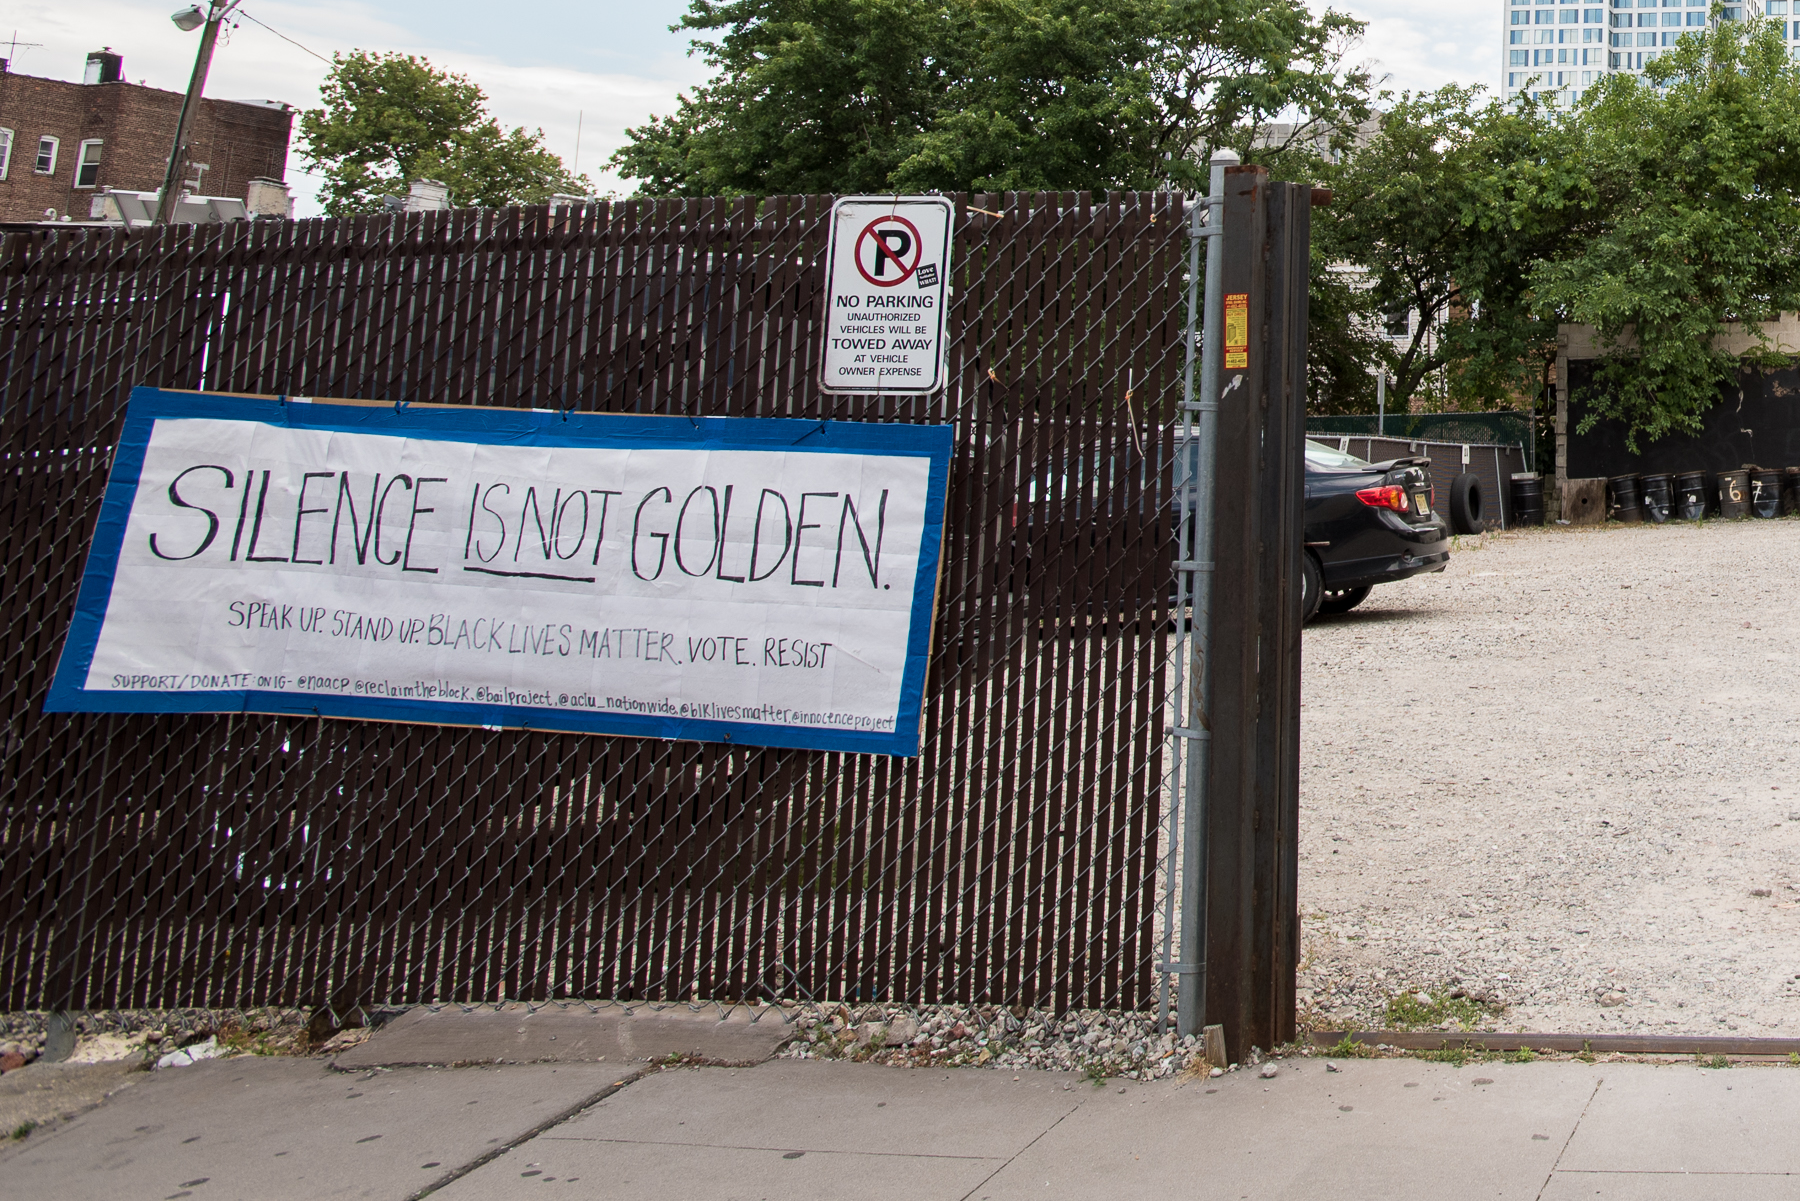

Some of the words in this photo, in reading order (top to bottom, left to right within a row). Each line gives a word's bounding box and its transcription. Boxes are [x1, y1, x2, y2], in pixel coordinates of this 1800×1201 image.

[837, 295, 859, 308] NO
[866, 296, 934, 308] PARKING
[847, 313, 920, 321] UNAUTHORIZED
[889, 326, 911, 334] WILL
[915, 326, 926, 334] BE
[832, 338, 886, 349] TOWED
[892, 339, 932, 350] AWAY
[839, 367, 875, 375] OWNER
[1730, 480, 1741, 500] 6
[150, 464, 448, 573] SILENCE
[465, 483, 510, 562] IS
[514, 487, 622, 565] NOT
[632, 484, 890, 590] GOLDEN.
[228, 601, 293, 630] SPEAK
[300, 607, 326, 633] UP.
[332, 610, 393, 641] STAND
[400, 618, 424, 643] UP.
[427, 614, 505, 652] BLACK
[509, 624, 572, 656] LIVES
[579, 628, 683, 666] MATTER.
[688, 636, 756, 666] VOTE.
[764, 637, 832, 668] RESIST
[792, 710, 895, 731] @innocenceproject
